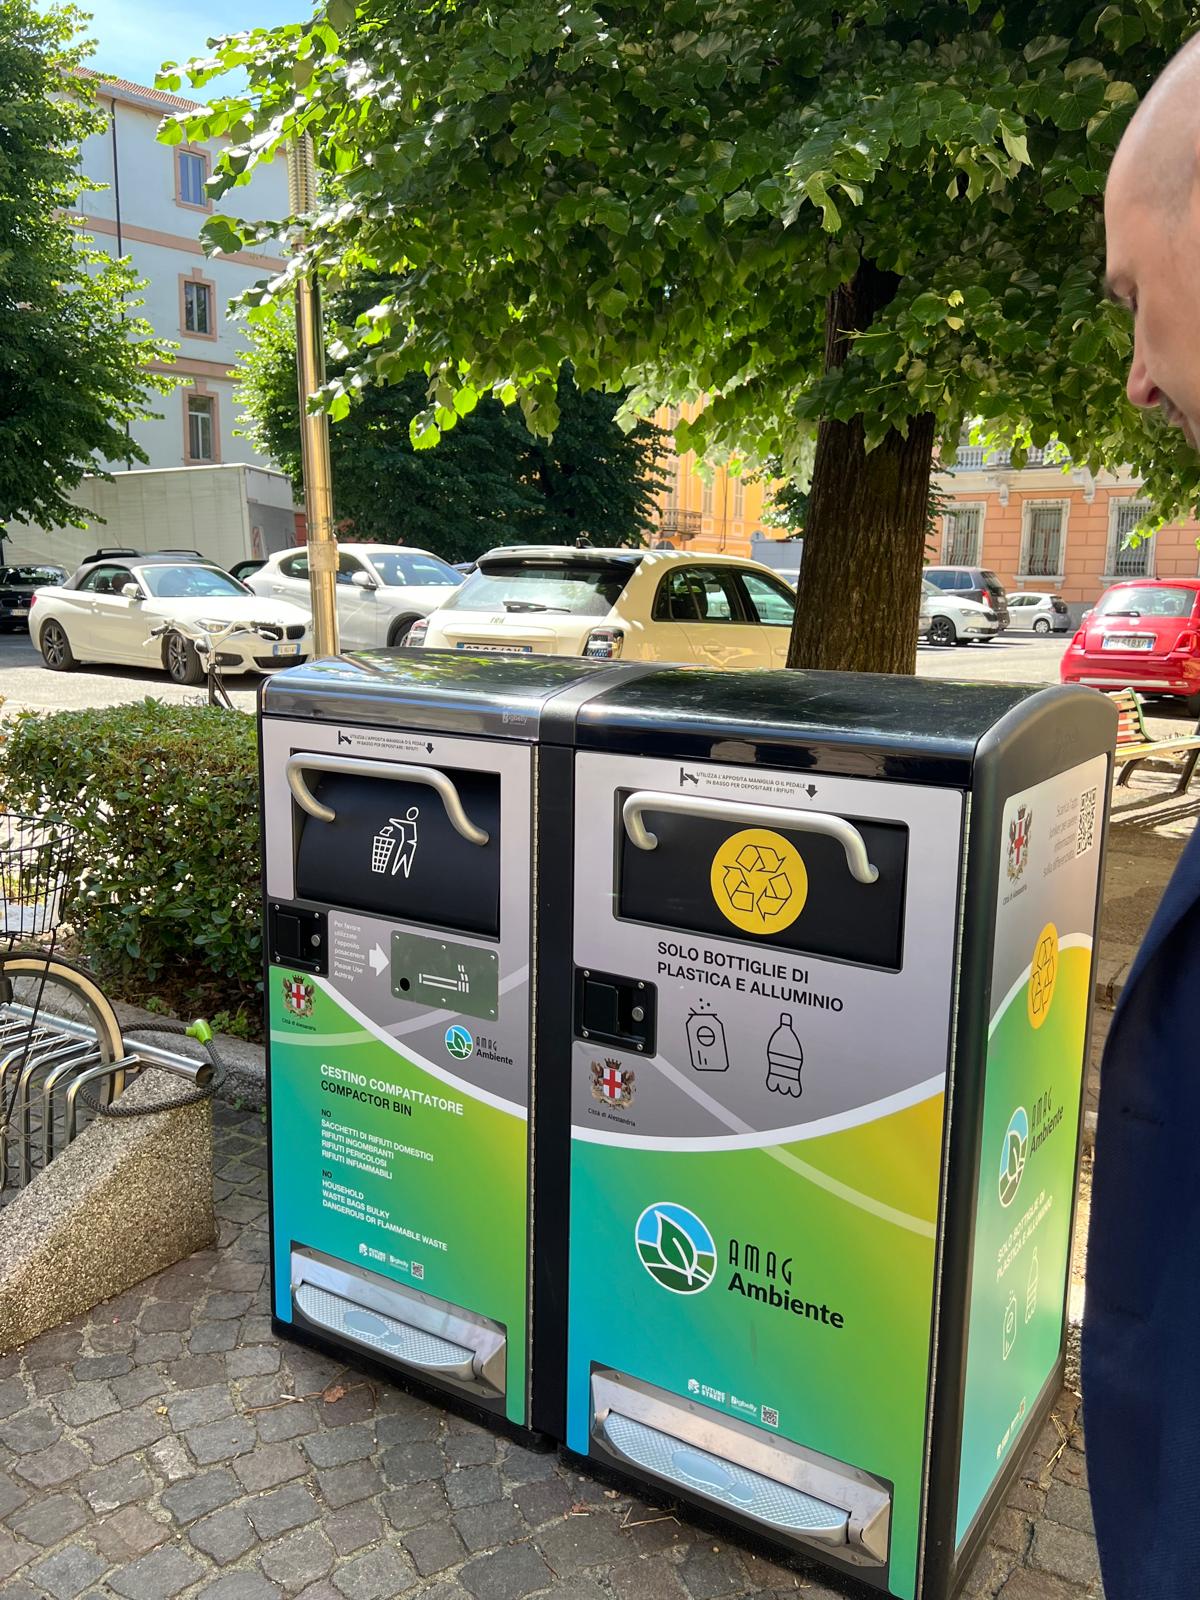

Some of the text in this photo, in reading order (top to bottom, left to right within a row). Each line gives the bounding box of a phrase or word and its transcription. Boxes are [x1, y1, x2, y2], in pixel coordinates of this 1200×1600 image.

[741, 783, 773, 792] DEPOSITARE
[344, 922, 360, 932] favore
[334, 961, 363, 974] Please Use
[658, 941, 809, 984] SOLO BOTTIGLIE DI
[658, 962, 843, 1012] PLASTICA E ALLUMINIO
[476, 1036, 496, 1051] AMAG
[477, 1049, 513, 1065] Ambiente
[320, 1064, 464, 1116] CESTINO COMPATTATORE
[321, 1080, 412, 1116] COMPACTOR BIN
[321, 1109, 331, 1118] NO
[608, 1114, 635, 1127] Alessandria
[321, 1119, 434, 1162] SACCHETTI DI RIFIUTI DOMESTICI
[322, 1129, 394, 1159] RIFIUTI INGOMBRANTI
[1030, 1106, 1063, 1158] Ambiente
[322, 1140, 387, 1167] RIFIUTI PERICOLOSI
[322, 1150, 392, 1180] RIFIUTI INFIAMMABILI
[322, 1169, 332, 1179] NO
[322, 1179, 364, 1200] HOUSEHOLD
[322, 1190, 390, 1219] WASTE BAGS BULKY
[322, 1199, 448, 1251] DANGEROUS OR FLAMMABLE WASTE
[728, 1239, 792, 1286] AMAG
[728, 1272, 844, 1329] Ambiente
